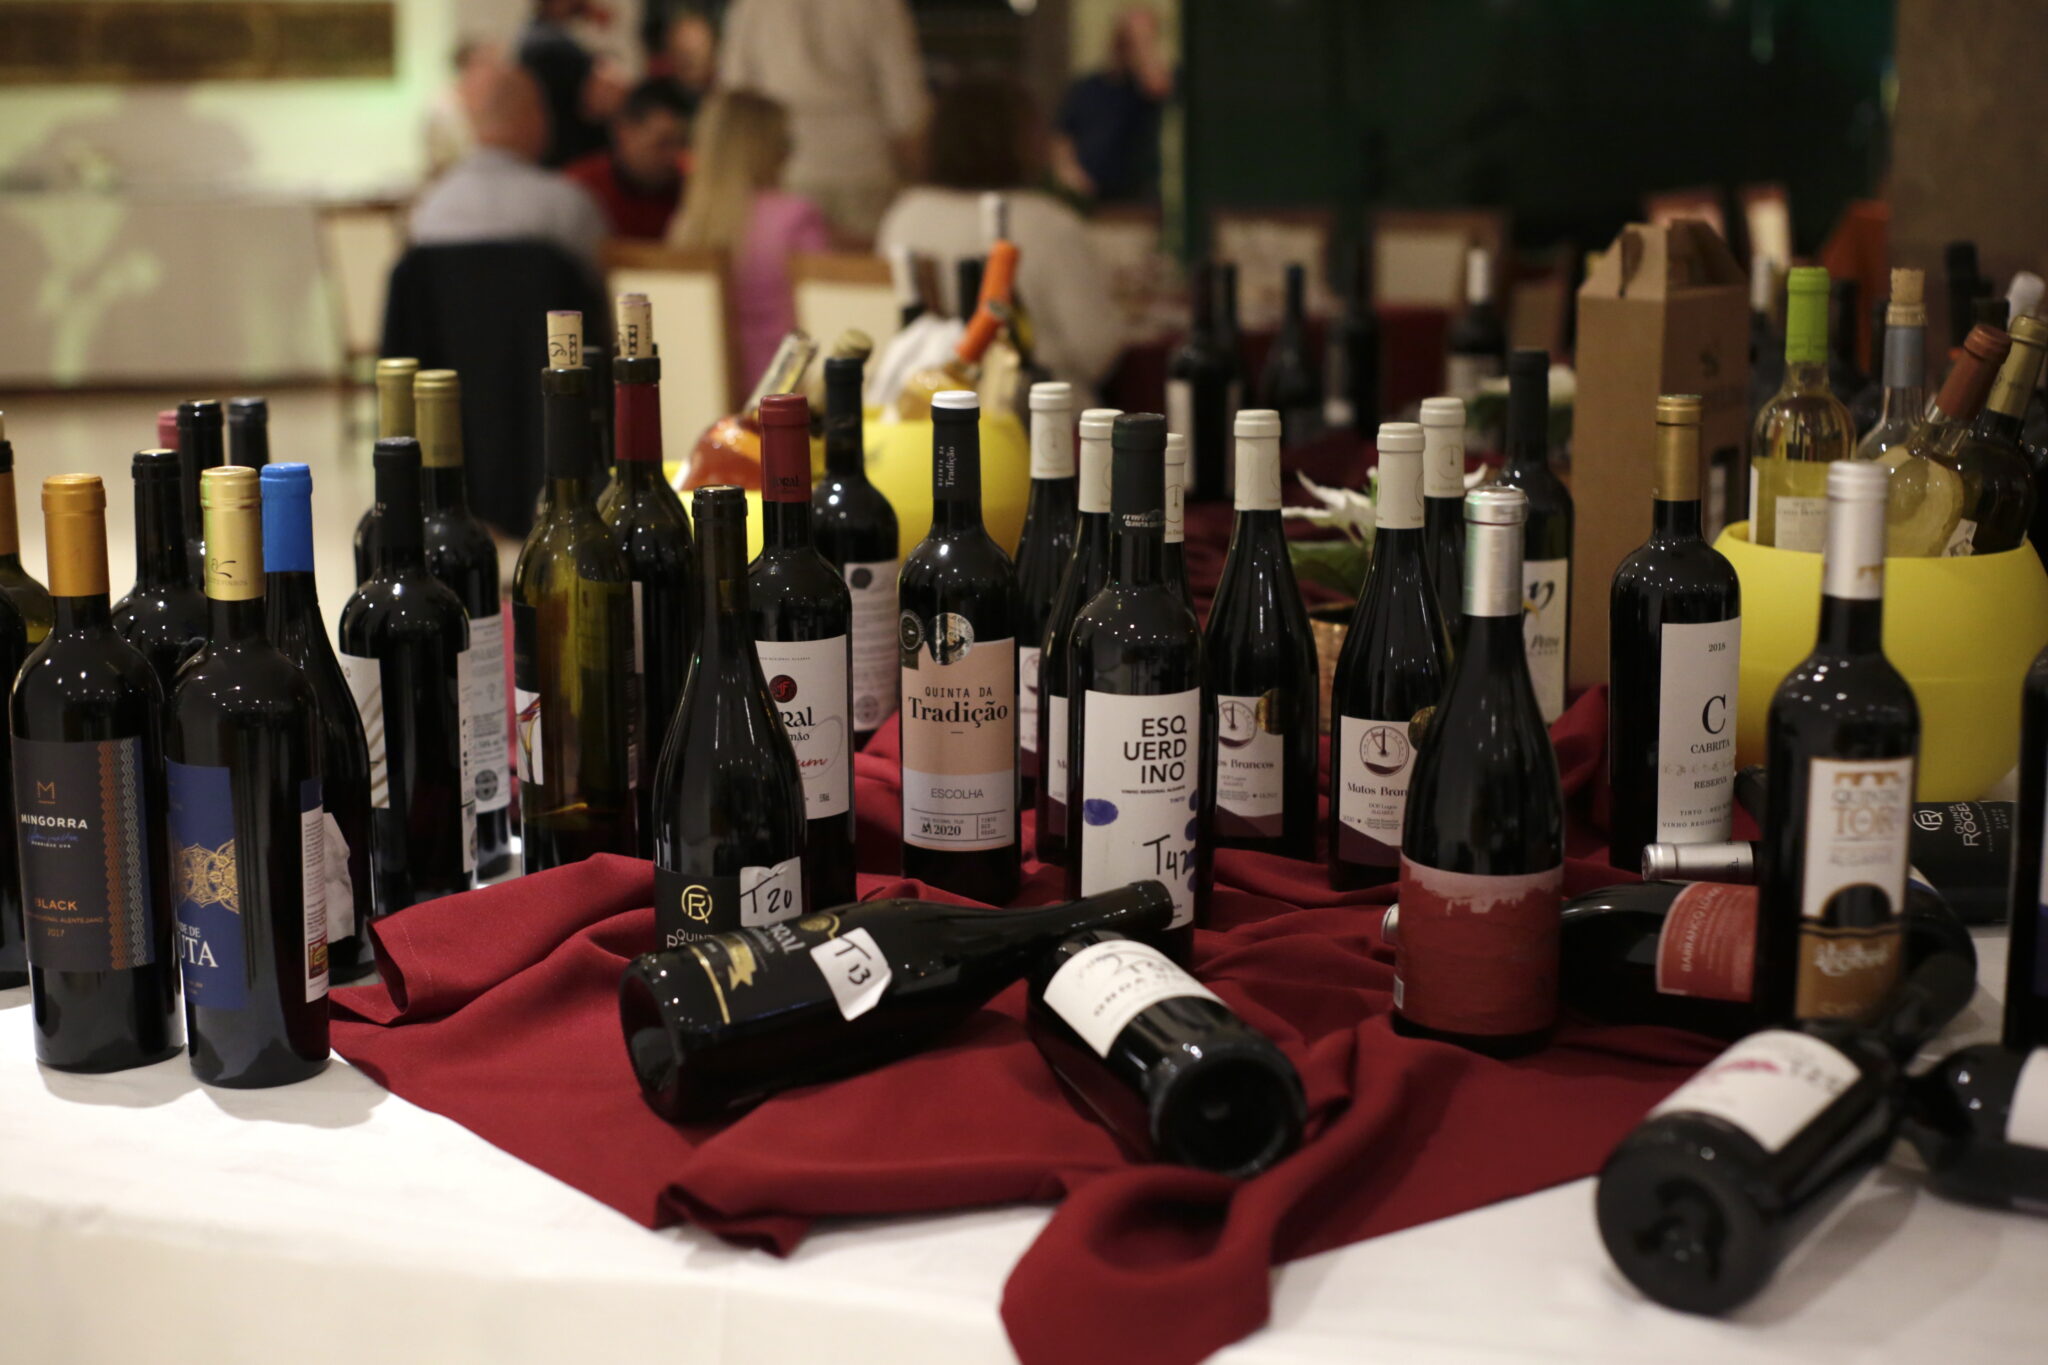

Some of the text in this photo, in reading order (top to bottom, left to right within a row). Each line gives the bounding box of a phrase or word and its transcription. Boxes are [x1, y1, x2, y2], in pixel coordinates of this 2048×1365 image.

[925, 686, 993, 698] QUINTA DA
[908, 696, 1009, 728] Tradição
[1702, 695, 1727, 734] C
[1142, 715, 1187, 737] ESQ
[1123, 739, 1187, 761] UERD
[1690, 739, 1731, 755] CABRITA
[1230, 757, 1274, 770] Brancos
[1141, 762, 1185, 784] INO
[930, 788, 985, 800] ESCOLHA
[1348, 782, 1376, 795] Matos
[21, 813, 88, 830] MINGORRA
[934, 824, 962, 836] 2020
[34, 898, 78, 911] BLACK
